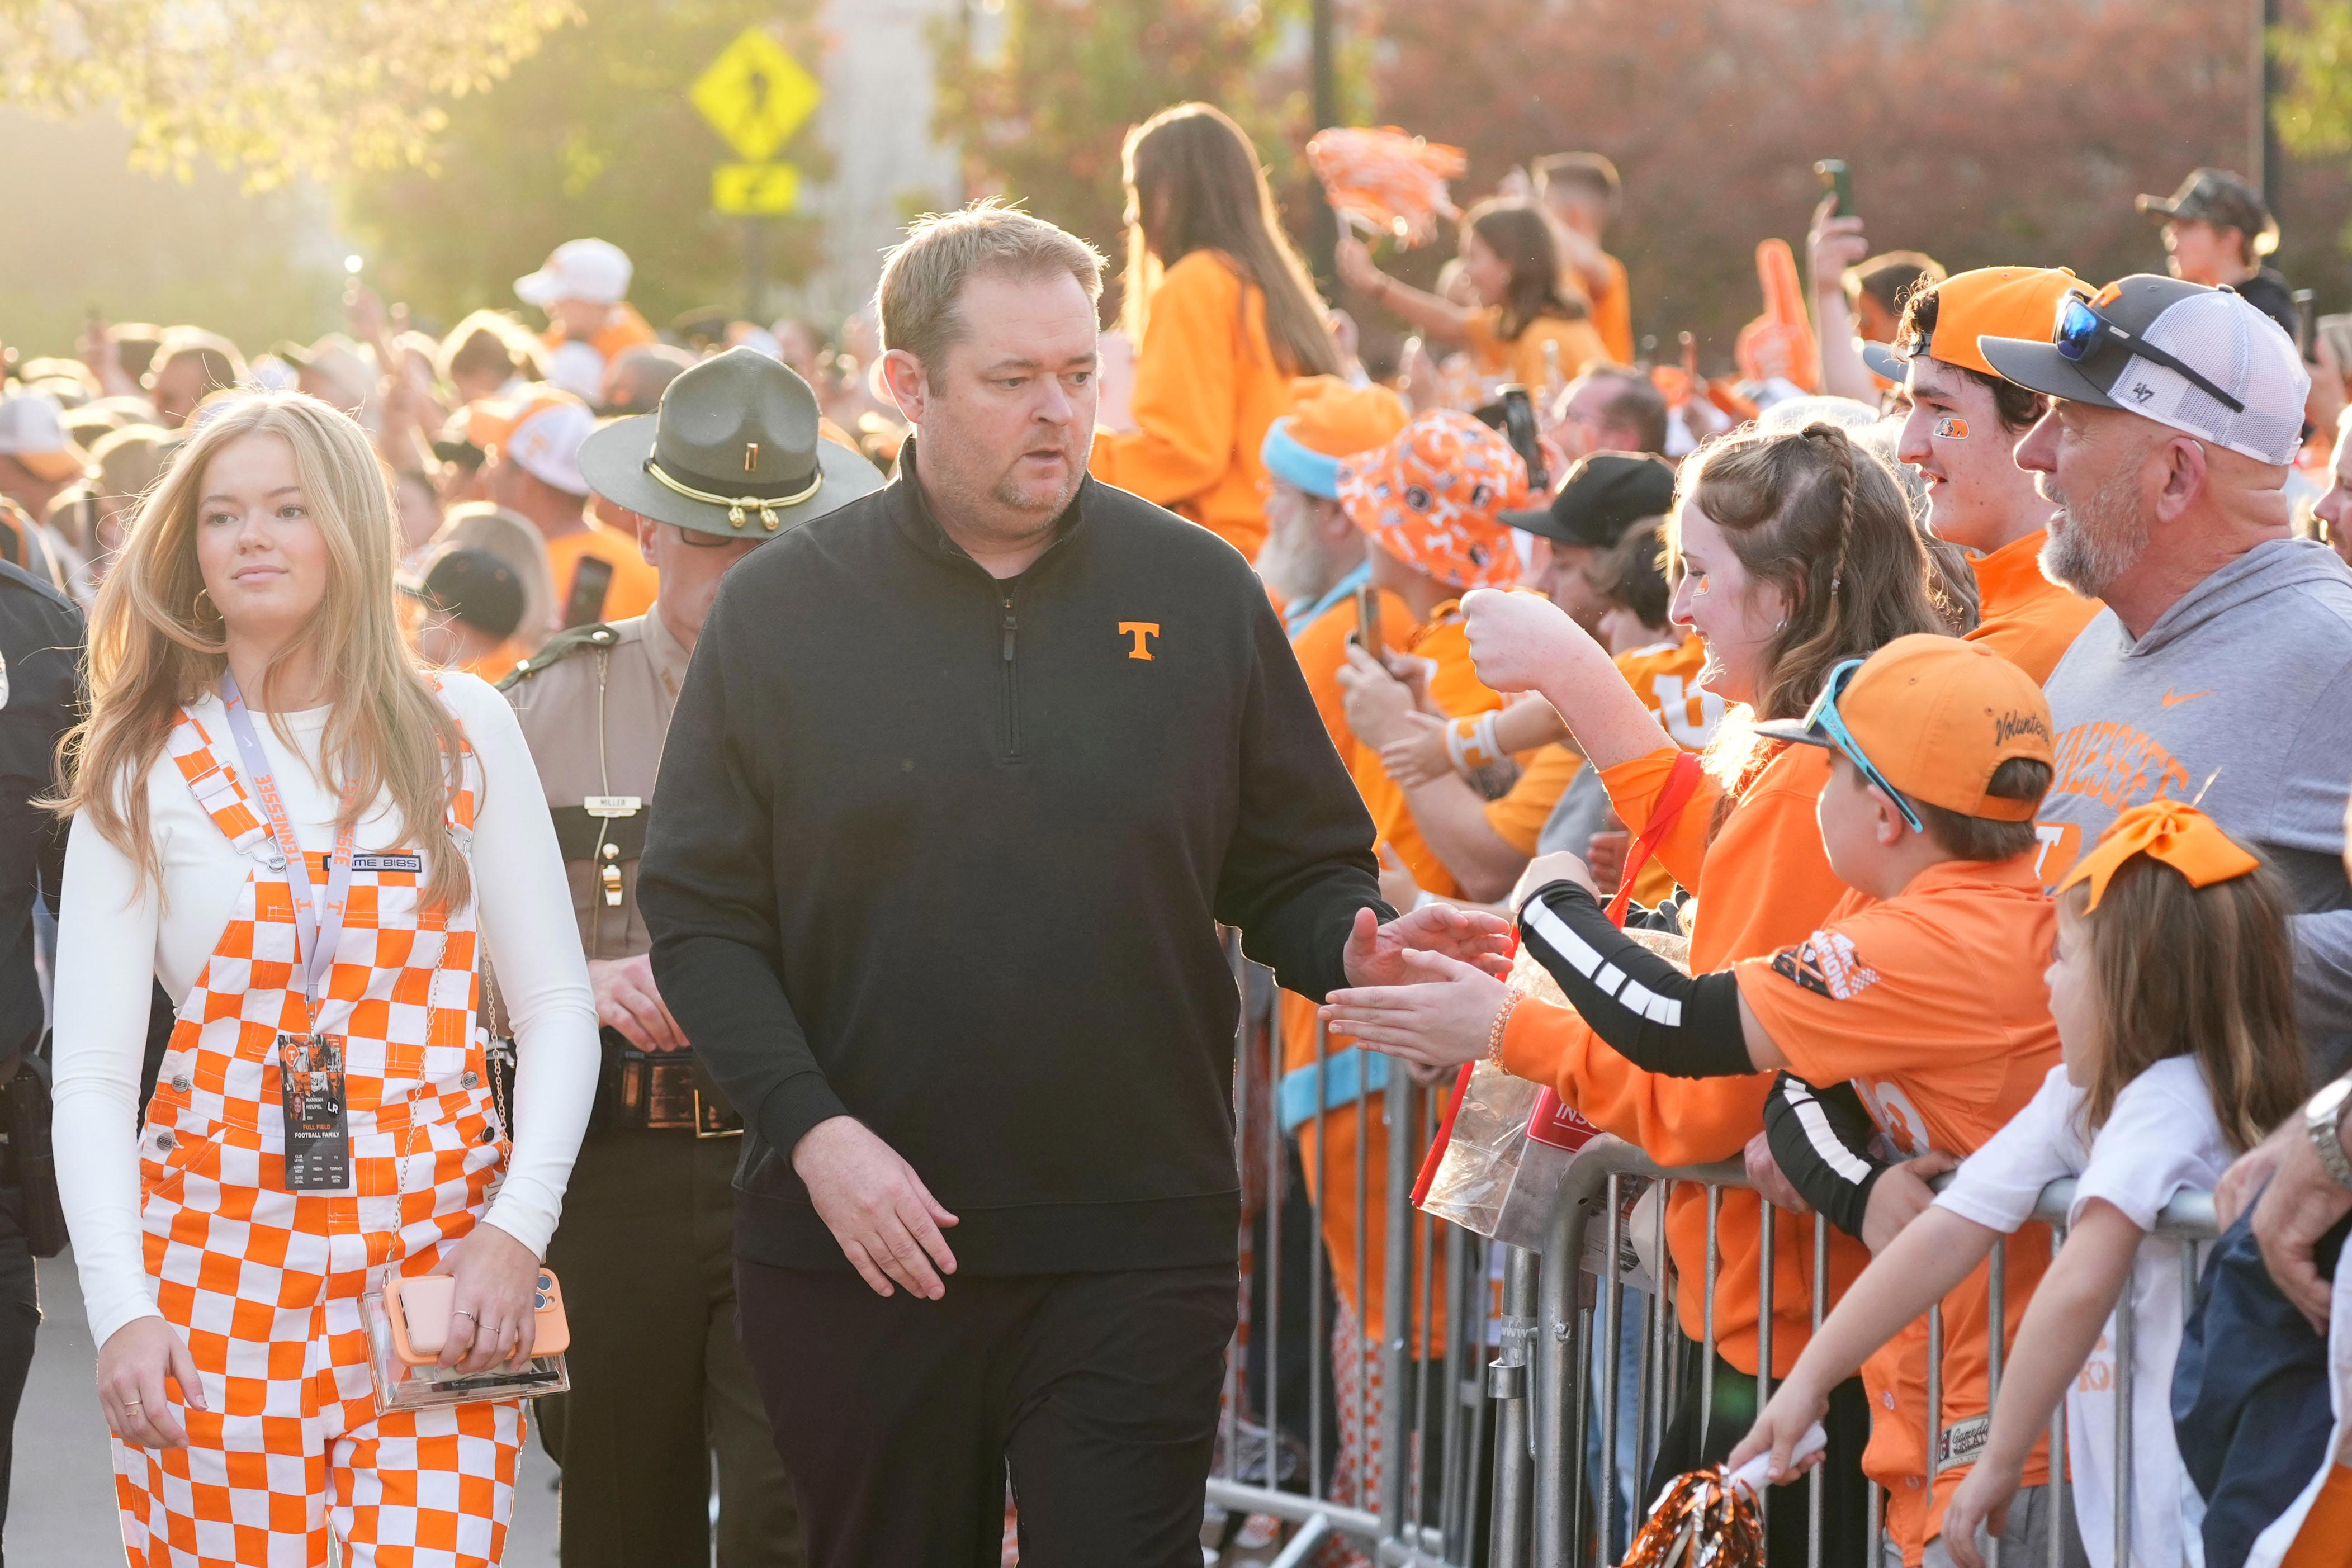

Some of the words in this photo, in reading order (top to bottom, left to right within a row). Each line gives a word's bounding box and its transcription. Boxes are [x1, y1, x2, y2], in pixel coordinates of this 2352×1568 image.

[1119, 622, 1160, 660] T
[2055, 722, 2190, 814] NESSEE
[254, 774, 302, 865] TENNESSEE
[295, 898, 312, 913] T
[327, 901, 344, 916] T
[327, 1101, 338, 1114] LR
